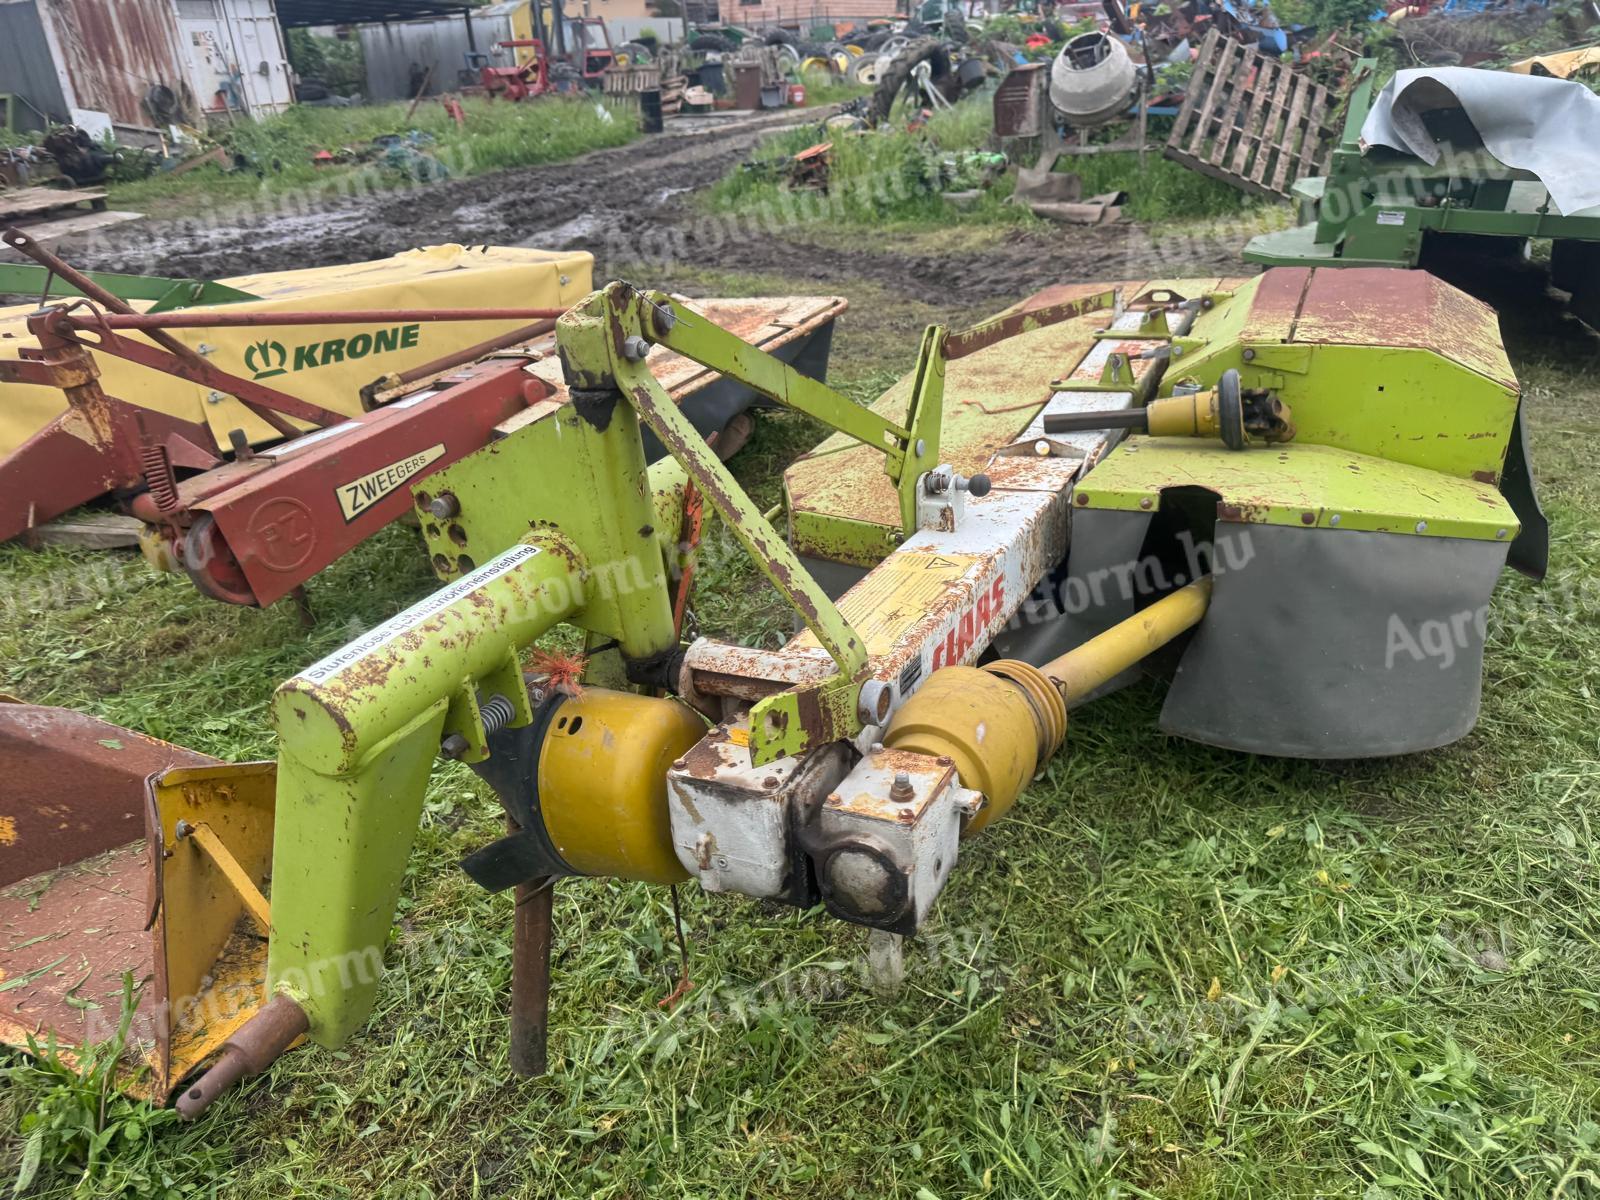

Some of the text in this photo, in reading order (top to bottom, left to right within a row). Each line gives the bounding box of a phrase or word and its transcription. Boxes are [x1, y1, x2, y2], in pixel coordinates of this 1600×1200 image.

[293, 323, 420, 371] KRONE
[345, 455, 427, 512] ZWEEGERS
[932, 573, 1005, 673] CLAAS
[308, 629, 392, 680] Stufenlose
